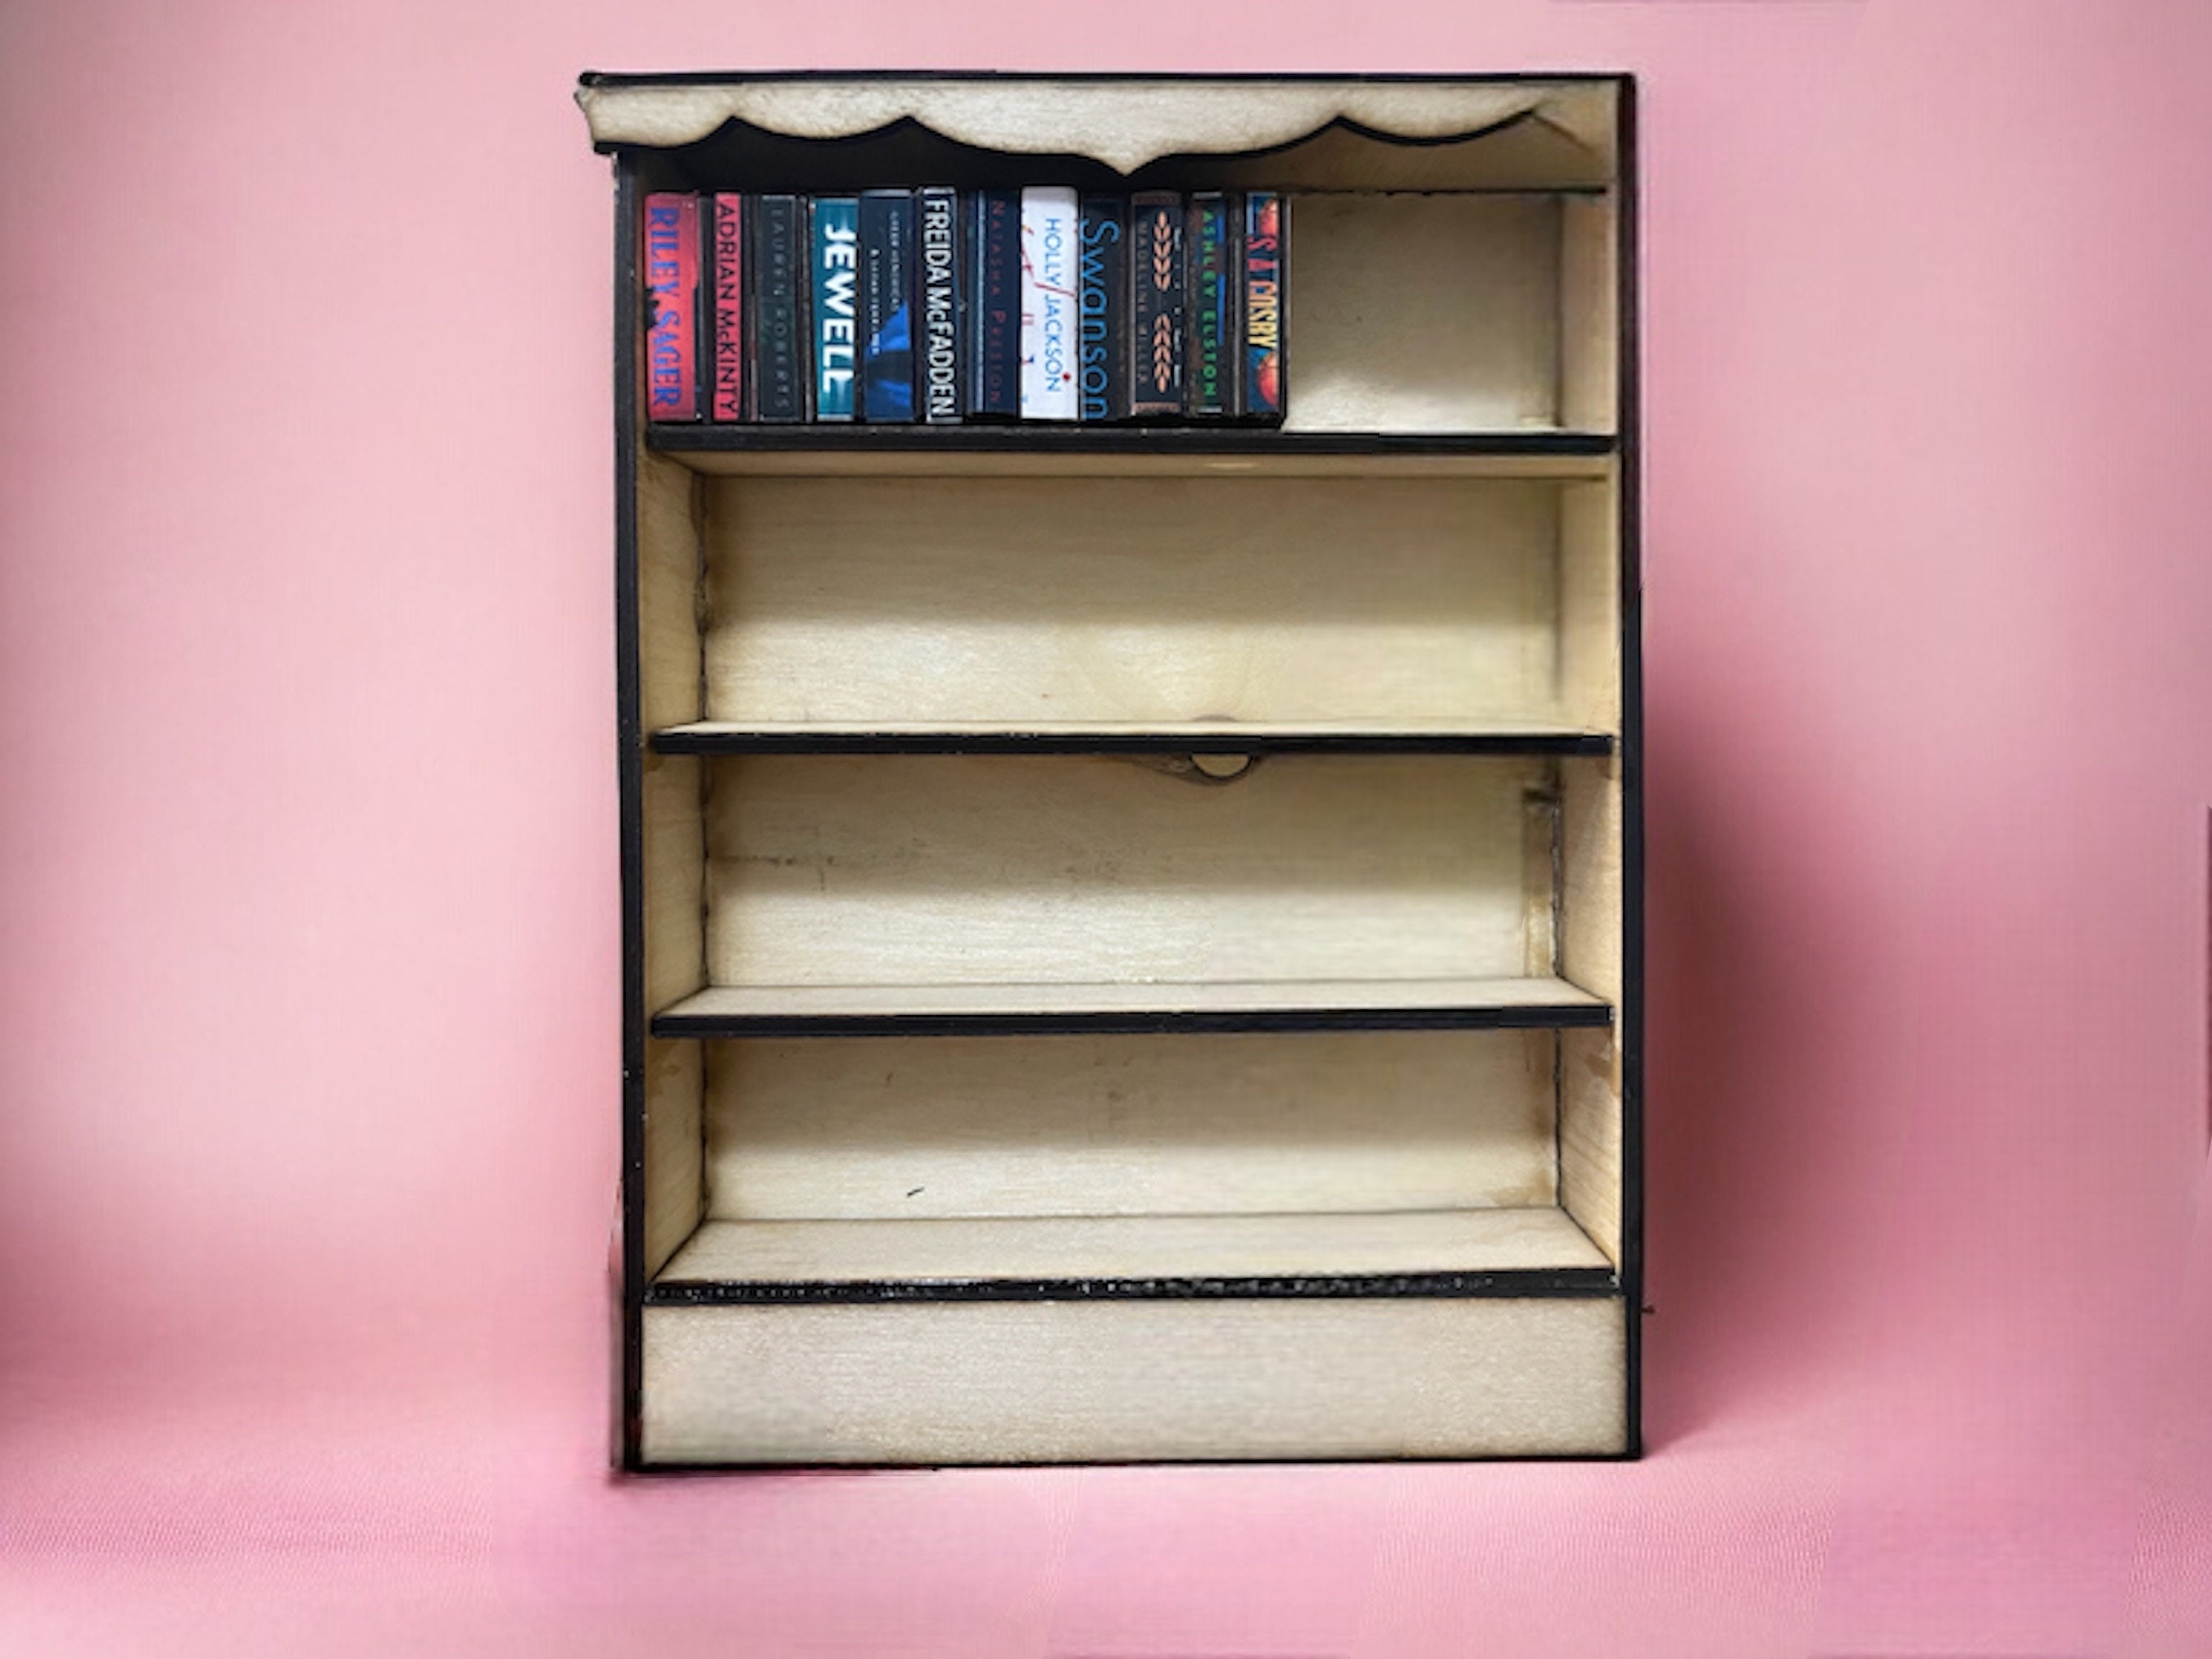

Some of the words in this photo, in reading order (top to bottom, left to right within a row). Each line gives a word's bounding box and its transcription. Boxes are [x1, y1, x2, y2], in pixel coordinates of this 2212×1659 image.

[649, 208, 679, 297] RILEY
[718, 205, 737, 305] ADRIAN
[923, 200, 952, 284] FREIDA
[1045, 218, 1063, 286] HOLLY
[1203, 211, 1217, 298] ASHLEY
[823, 223, 856, 393] JEWELL
[926, 287, 956, 415] McFADDEN
[1045, 295, 1063, 392] JACKSON
[1080, 219, 1120, 419] Swanson
[1203, 310, 1217, 397] ELSTON
[652, 310, 682, 406] SAGER
[718, 308, 737, 414] McKINTY
